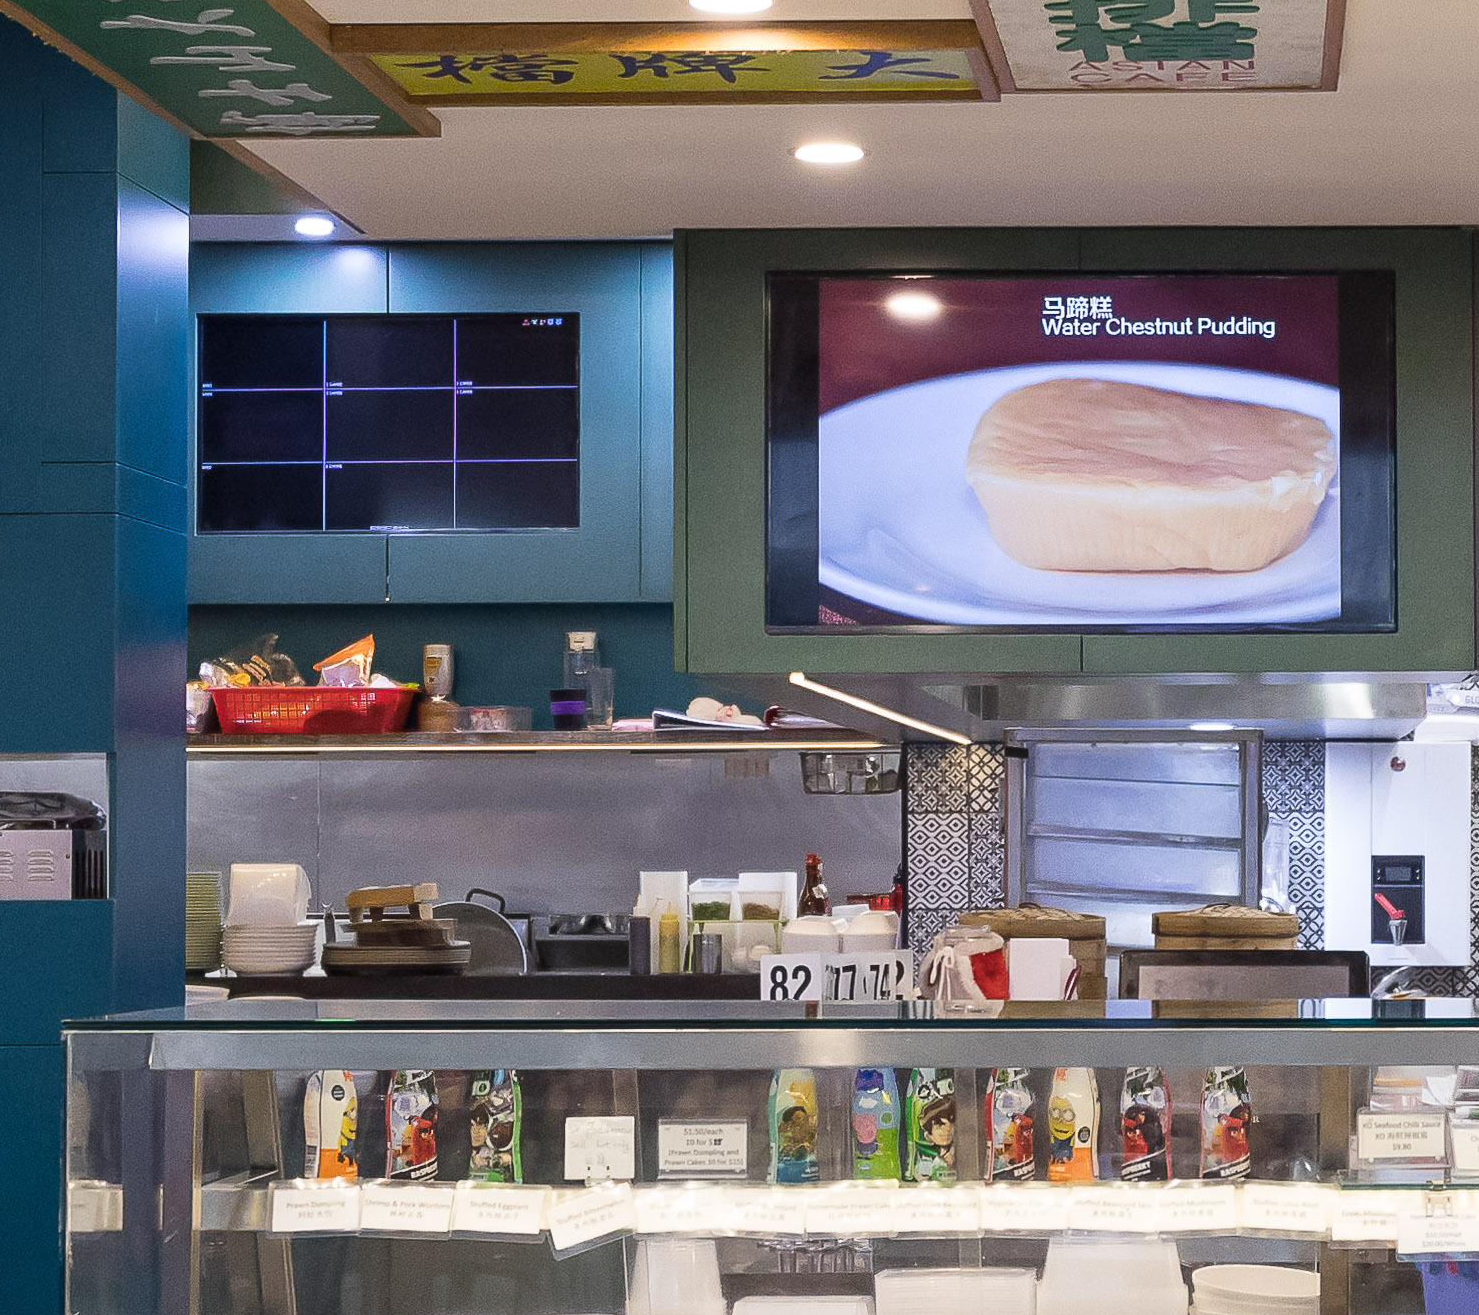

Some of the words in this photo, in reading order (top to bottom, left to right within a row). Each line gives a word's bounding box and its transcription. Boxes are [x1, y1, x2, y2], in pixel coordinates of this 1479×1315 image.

[1069, 60, 1256, 72] ASIAN
[1070, 72, 1257, 83] CAFE
[1042, 296, 1113, 319] 马蹄糕
[1042, 318, 1100, 336] Water
[1105, 317, 1193, 336] Chestnut
[1198, 317, 1276, 339] Pudding
[770, 965, 812, 1000] 82
[1374, 1121, 1401, 1129] Seafood
